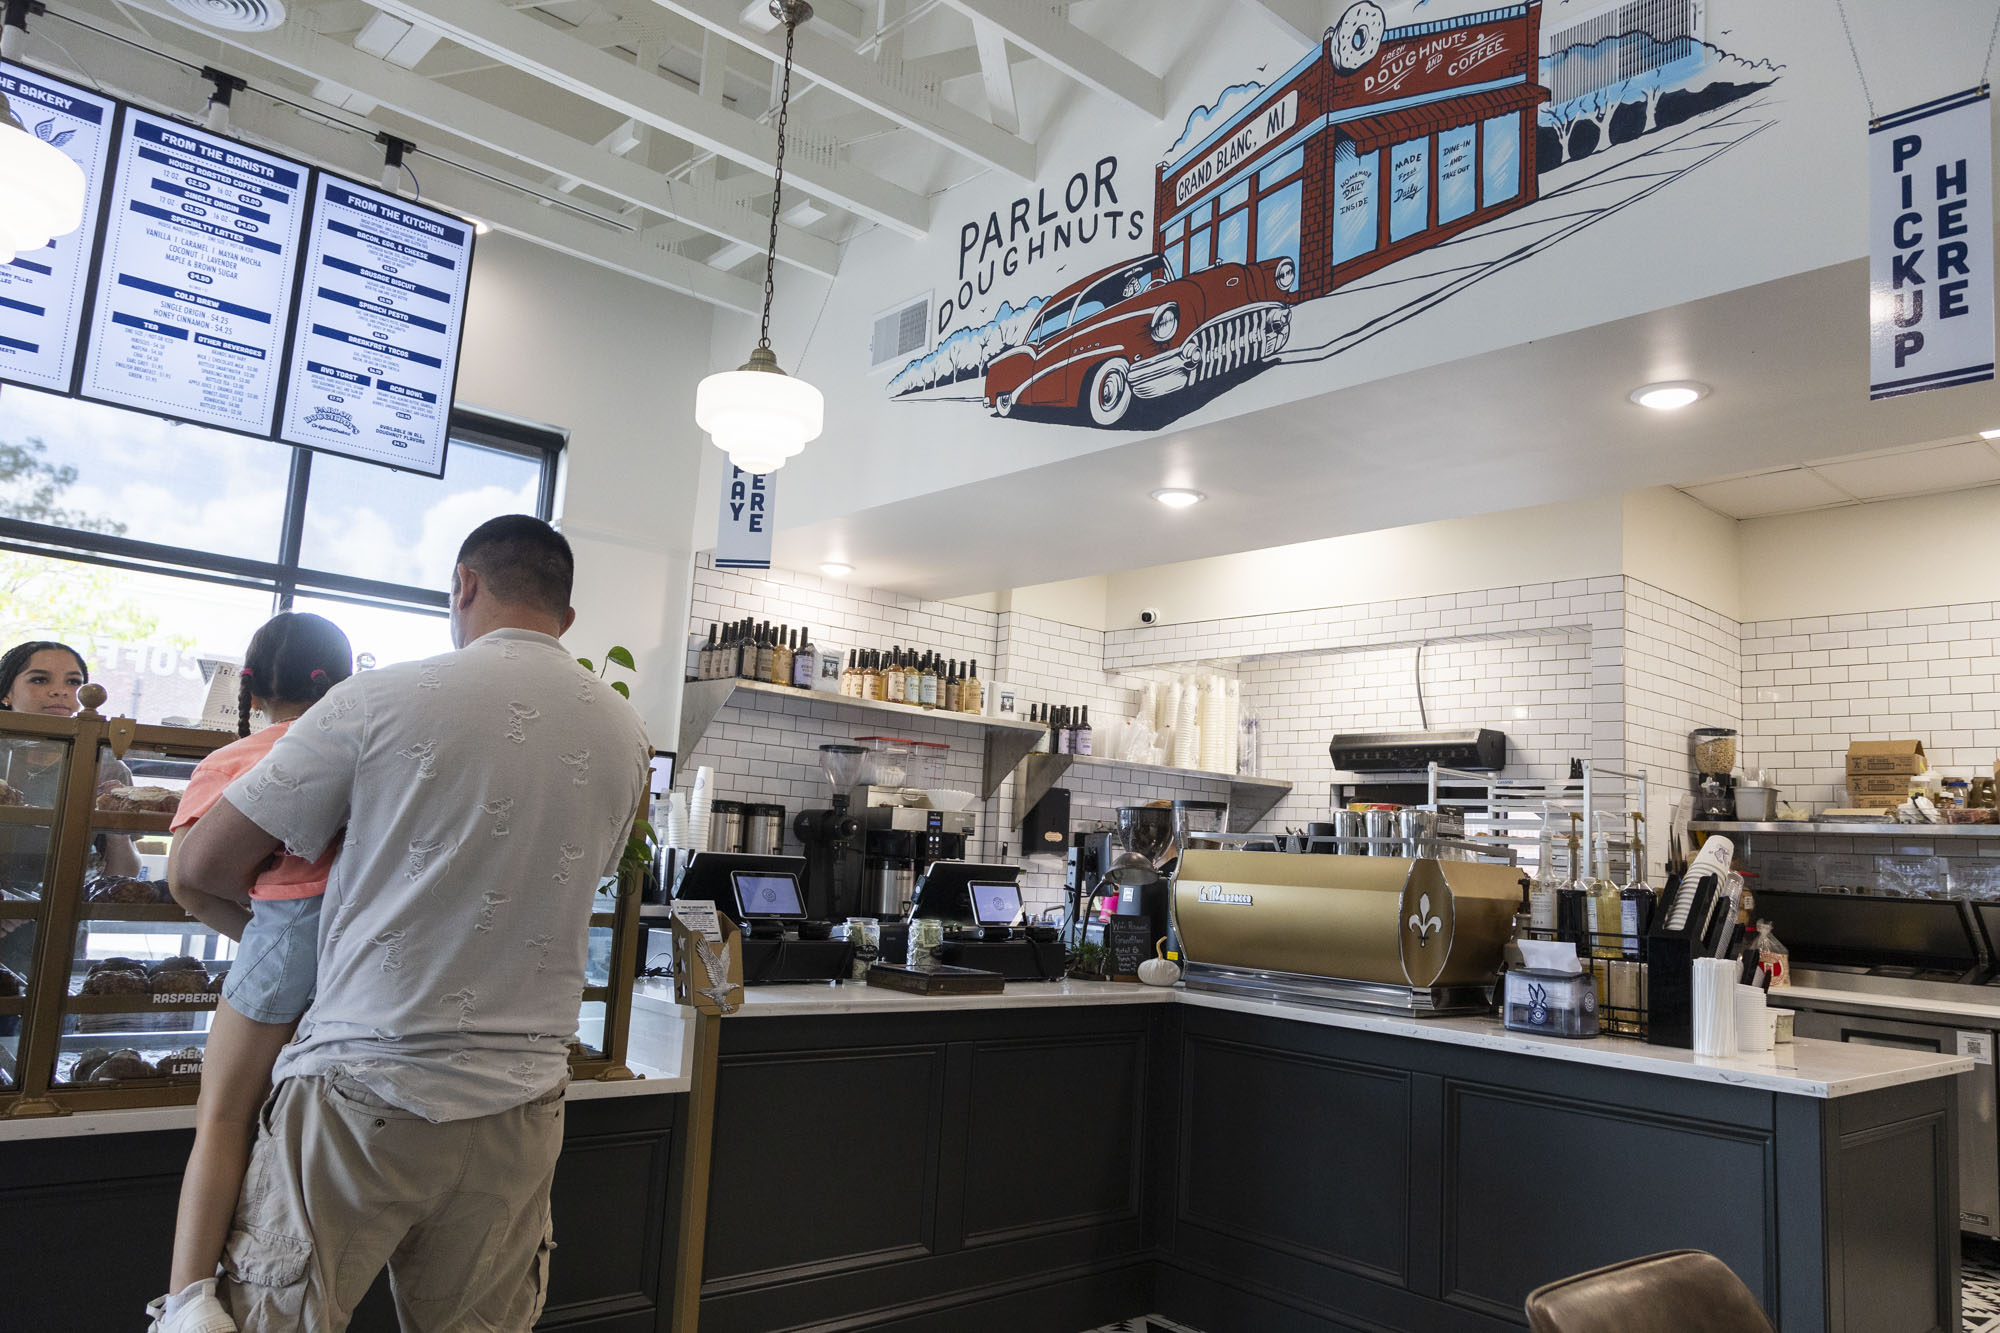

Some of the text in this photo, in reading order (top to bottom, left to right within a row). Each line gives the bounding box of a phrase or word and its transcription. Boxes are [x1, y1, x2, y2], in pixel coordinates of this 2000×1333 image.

[1364, 32, 1467, 92] DOUGHNUTS
[1380, 44, 1406, 64] FRESH
[1425, 54, 1443, 71] AND
[1448, 38, 1504, 76] COFFEE
[19, 84, 73, 109] BAKERY
[161, 132, 274, 178] FROM THE BARISTA
[1178, 101, 1285, 201] GRAND BLANC, MI
[1443, 139, 1471, 156] DINE-IN
[1395, 153, 1422, 171] MADE
[168, 158, 262, 194] HOUSE ROASTED COFFEE
[183, 190, 239, 213] SINGLE ORIGIN
[1342, 182, 1365, 199] DAILY
[1394, 184, 1424, 203] Daily
[347, 195, 377, 212] FROM
[379, 206, 400, 220] THE
[402, 214, 444, 236] KITCHEN
[1340, 197, 1368, 215] INSIDE
[170, 214, 244, 242] SPECIALTY LATTES
[959, 156, 1118, 281] PARLOR
[145, 227, 261, 267] VANILLA CARAMEL MAYAN MOCHA
[1936, 159, 1970, 320] HERE
[168, 244, 237, 270] COCONUT LAVENDER
[404, 246, 428, 259] CHEESE
[1893, 134, 1926, 369] PICKUP
[165, 253, 185, 265] MAPLE
[193, 261, 216, 273] BROWN
[218, 268, 238, 280] SUGAR
[938, 210, 1144, 335] DOUGHNUTS
[360, 268, 389, 283] SAUSAGE
[390, 278, 416, 291] BISCUIT
[174, 290, 194, 301] COLD
[153, 307, 232, 335] HONEY CINNAMON $4.25
[160, 300, 228, 325] SINGLE ORIGIN $4.25
[358, 300, 408, 321] SPINACH PESTO
[197, 335, 262, 357] OTHER BEVERAGES
[348, 335, 408, 357] BREAKFAST TACOS
[320, 366, 358, 381] AVO TOAST
[389, 384, 424, 399] ACAI BOWL
[375, 428, 424, 444] DOUGHNUT FLAVORS
[379, 424, 405, 434] AVAILABLE
[730, 465, 746, 521] PAY
[749, 474, 766, 532] ERE
[170, 1049, 204, 1059] DREA
[172, 1063, 204, 1074] LEMO
